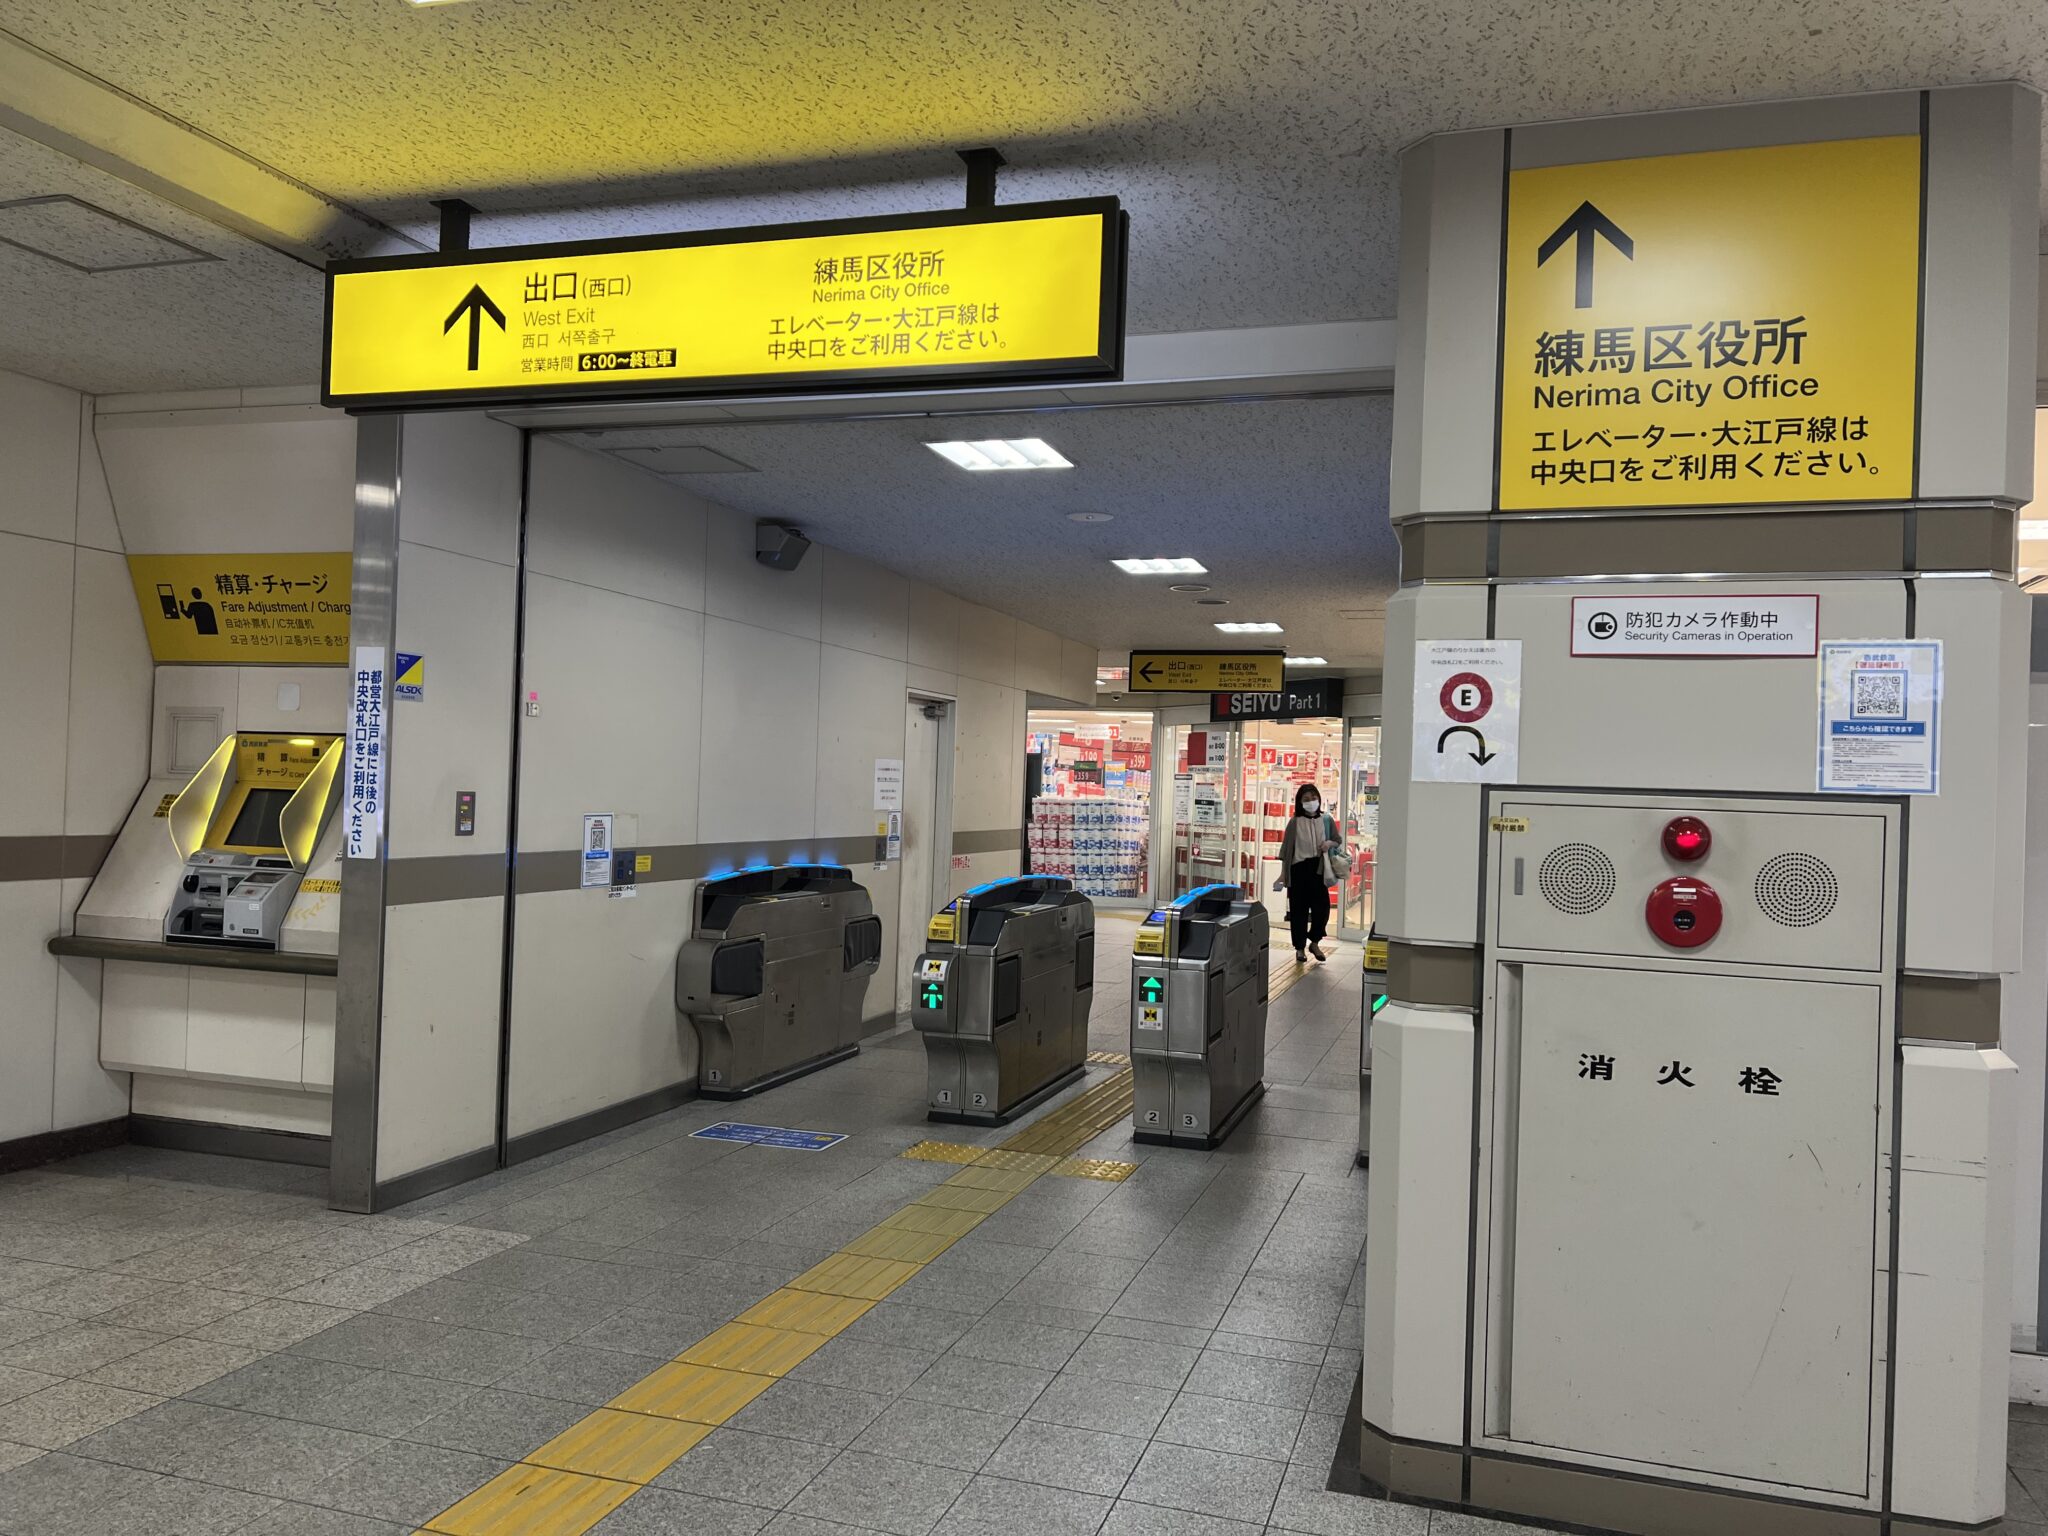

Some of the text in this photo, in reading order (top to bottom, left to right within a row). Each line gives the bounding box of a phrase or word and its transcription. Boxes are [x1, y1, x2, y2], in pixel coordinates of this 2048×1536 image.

[813, 249, 946, 285] 練馬区役所
[812, 281, 950, 304] Nerima City Office
[523, 307, 596, 327] West Exit
[769, 302, 1000, 336] エレベーター・大江戸線は
[521, 327, 617, 350] 西口 서쪽출구
[767, 328, 1007, 362] 中央口をご利用ください。
[1533, 315, 1808, 378] 練馬区役所
[520, 356, 573, 373] 営業時間
[1533, 374, 1820, 409] Nerima City Office
[1531, 415, 1870, 453] エレベーター・大江戸線は
[1530, 450, 1880, 486] 中央口をご利用ください。
[215, 573, 328, 596] 精算・チャージ
[220, 601, 245, 613] Fare
[248, 601, 309, 614] Adjustment
[1625, 610, 1780, 630] 防犯カメラ作動中
[1624, 630, 1794, 645] Security Cameras in Operation
[395, 685, 422, 695] ALSOK
[1460, 689, 1472, 706] E
[1231, 692, 1321, 714] SEIYU Part 1
[365, 669, 382, 815] 都営大江戸線には後の
[257, 767, 288, 777] チャージ
[350, 669, 370, 856] 中央改札口をご利用ください
[974, 1094, 982, 1105] 2
[1149, 1112, 1157, 1122] 2
[1184, 1115, 1193, 1126] 3
